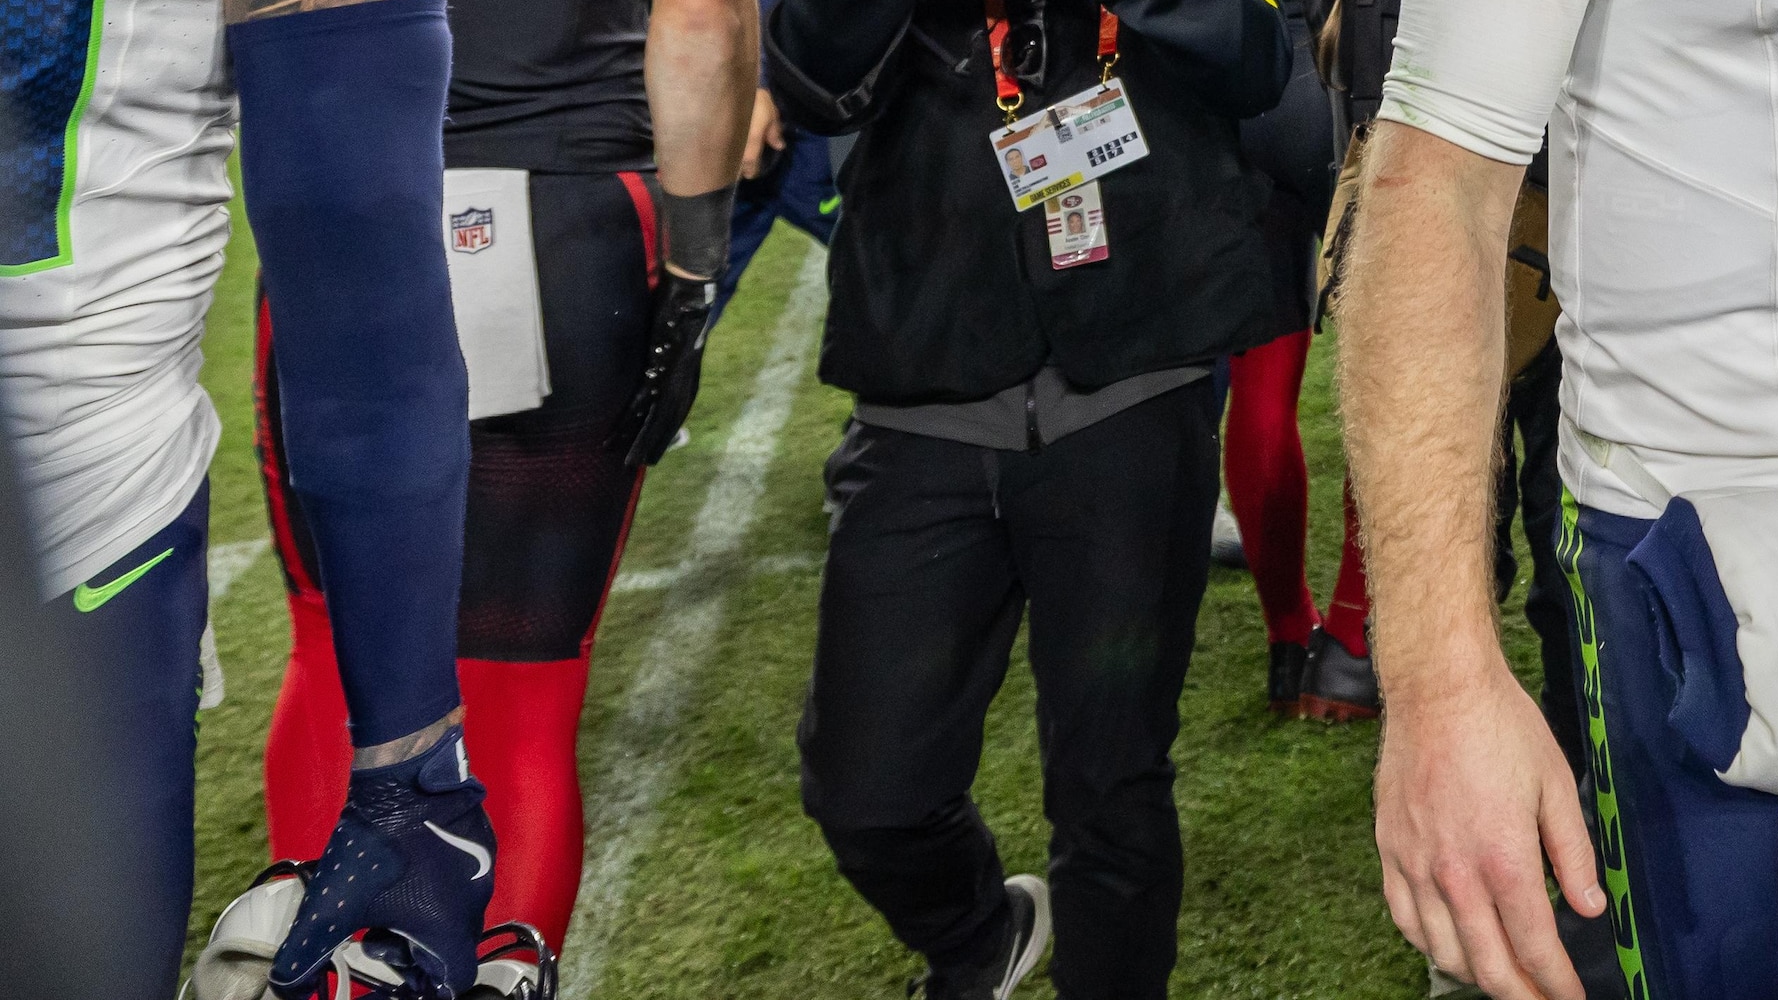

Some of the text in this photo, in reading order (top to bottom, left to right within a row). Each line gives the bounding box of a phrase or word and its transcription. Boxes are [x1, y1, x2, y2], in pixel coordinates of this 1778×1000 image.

[1029, 189, 1046, 203] GAME
[1045, 178, 1072, 197] SERVICES
[454, 225, 490, 249] NFL
